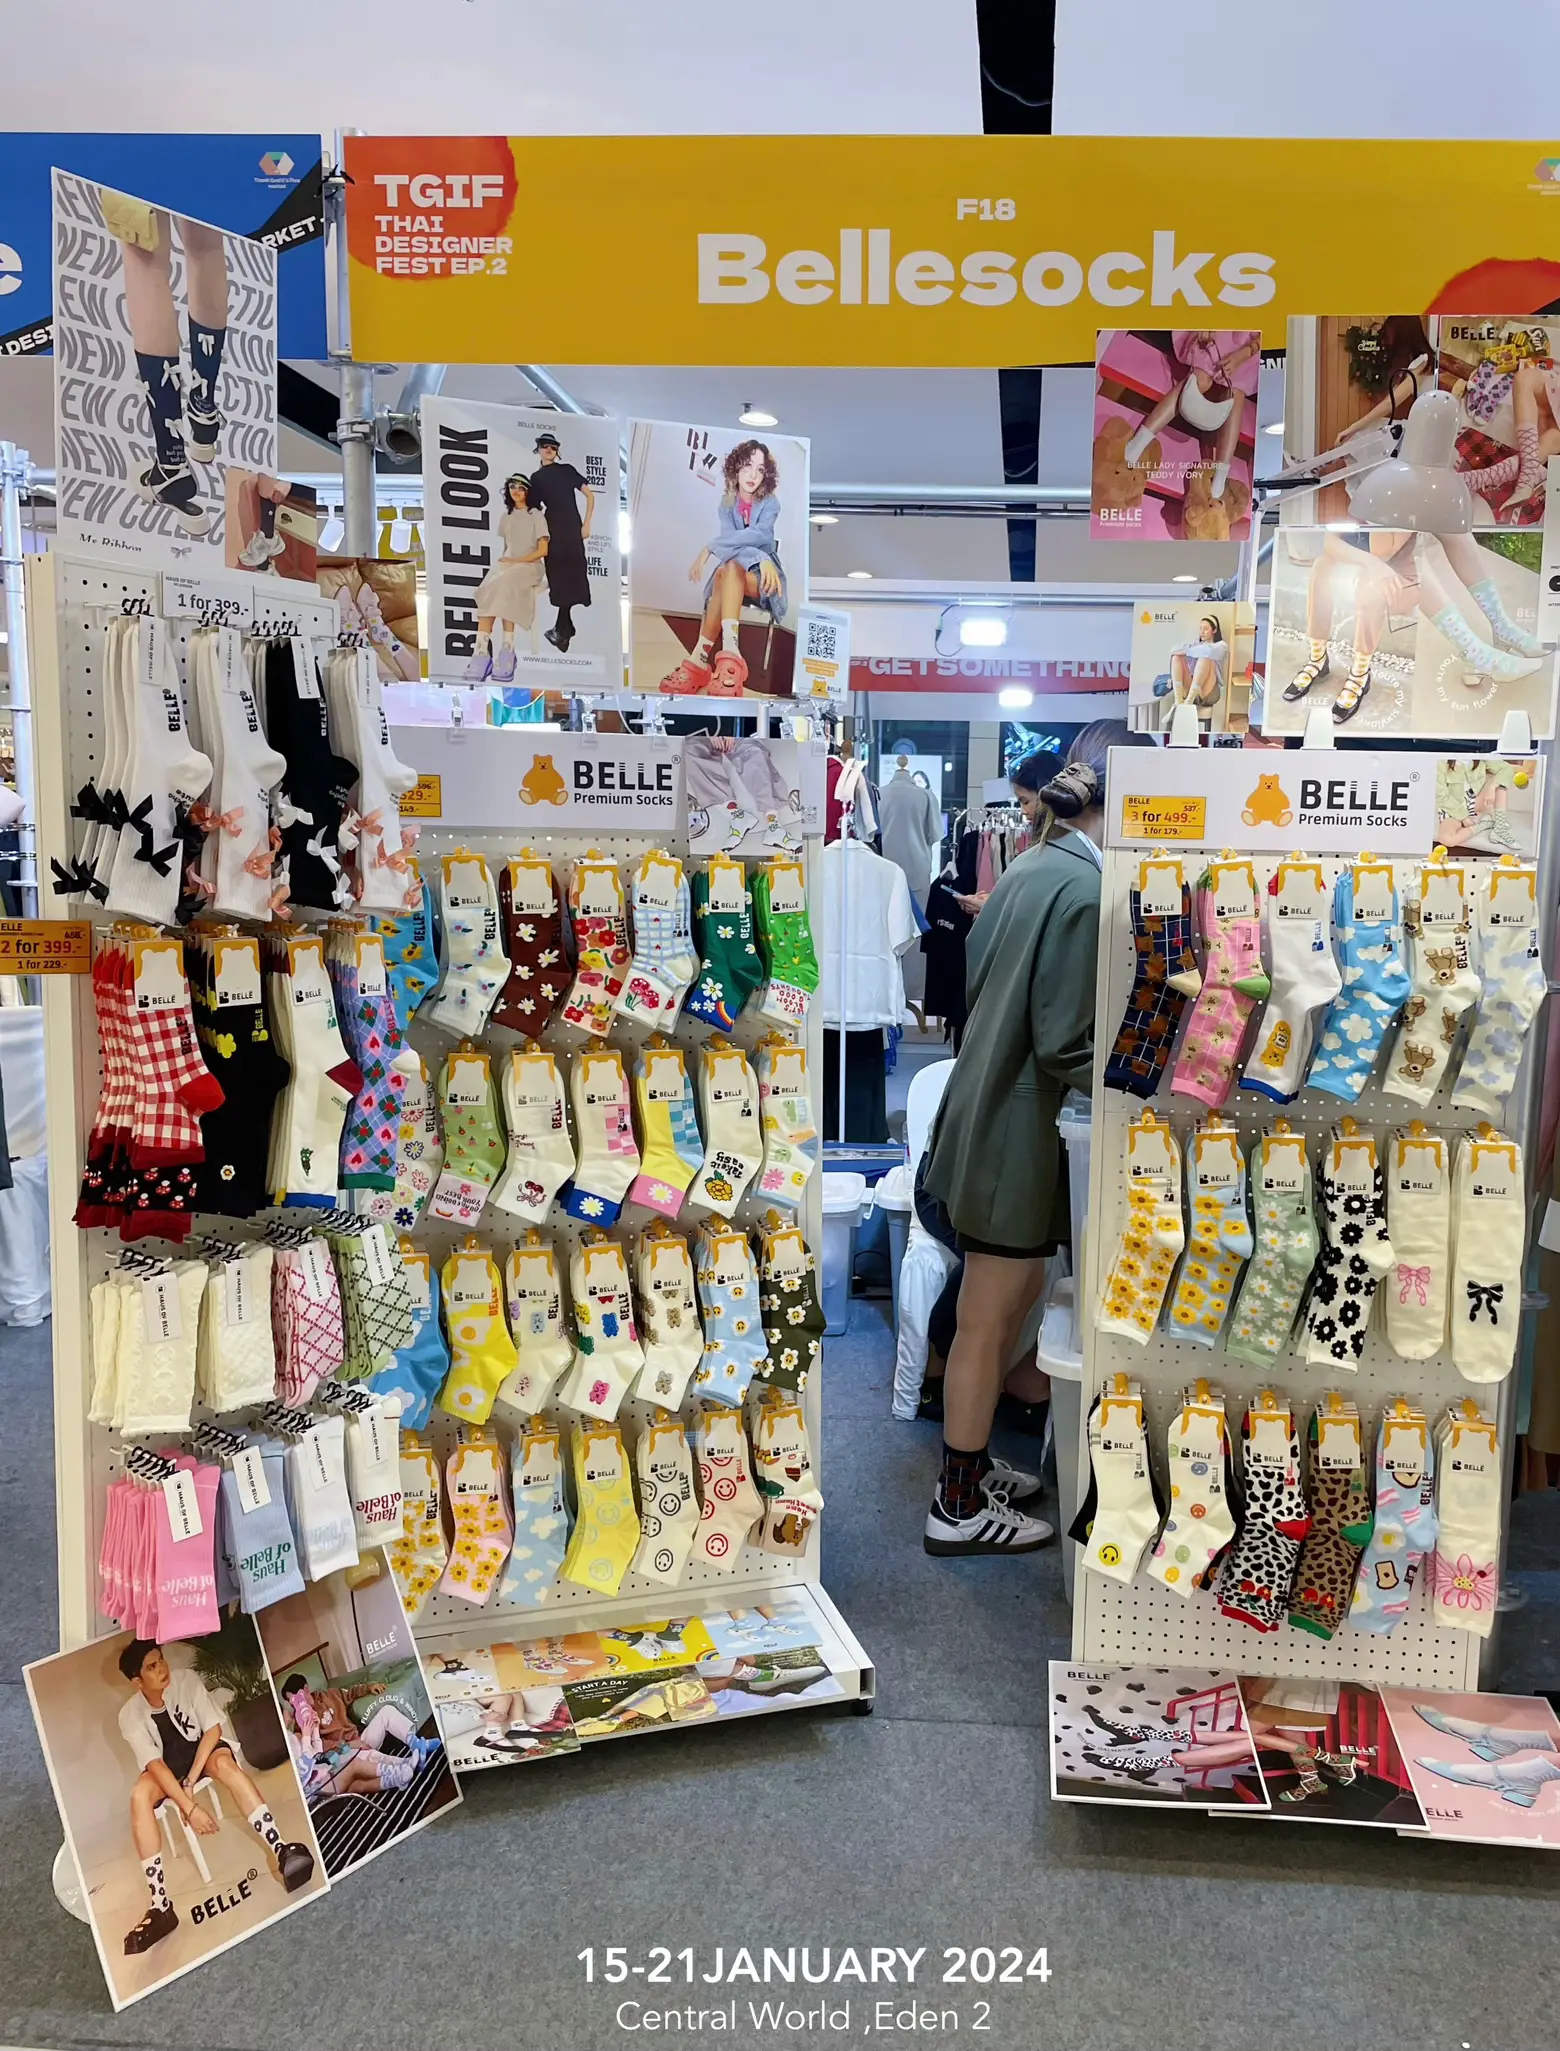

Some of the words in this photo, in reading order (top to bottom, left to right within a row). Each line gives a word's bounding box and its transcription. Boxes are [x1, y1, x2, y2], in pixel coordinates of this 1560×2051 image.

[374, 174, 504, 208] TGIF
[956, 197, 1017, 221] F18
[375, 215, 444, 233] THAI
[375, 236, 513, 254] DESIGNER
[376, 256, 447, 275] FEST
[451, 257, 508, 276] EP.2
[697, 228, 1277, 307] Bellesocks
[1450, 326, 1495, 341] BELLE
[586, 455, 603, 466] BEST
[439, 425, 490, 531] LOOK
[586, 465, 607, 477] STYLE
[1146, 471, 1174, 479] TEDDY
[1176, 471, 1204, 479] IVORY
[586, 475, 606, 487] 2023
[1100, 508, 1142, 521] BELLE
[587, 556, 602, 567] LIFE
[587, 566, 608, 578] STYLE
[178, 593, 187, 607] 1
[191, 594, 212, 611] for
[164, 694, 181, 732] BELLE
[241, 695, 258, 732] BELLE
[574, 759, 673, 791] BELLE
[574, 792, 633, 805] Premium
[636, 794, 673, 806] Socks
[1300, 779, 1410, 811] BELLE
[1131, 812, 1139, 821] 3
[1142, 811, 1161, 822] for
[1163, 812, 1197, 824] 499.-
[1299, 814, 1362, 826] Premium
[1366, 814, 1408, 827] Socks
[0, 923, 23, 932] ELLE
[484, 913, 496, 940] BELLE
[1, 940, 11, 954] 2
[16, 939, 40, 954] for
[44, 940, 82, 954] 399.-
[1457, 940, 1468, 969] BELLE
[17, 960, 24, 969] 1
[26, 960, 41, 969] for
[43, 960, 67, 969] 229.-
[162, 1321, 170, 1338] BELLE
[356, 1497, 388, 1512] Belle
[365, 1507, 397, 1524] Haus
[240, 1547, 274, 1571] Belle
[253, 1559, 286, 1583] Haus
[366, 1631, 397, 1655] BELLE
[1067, 1671, 1110, 1681] BELLE
[571, 1681, 600, 1693] START
[453, 1753, 499, 1767] BELLE
[1425, 1807, 1464, 1818] ELLE
[190, 1881, 252, 1925] BELLE
